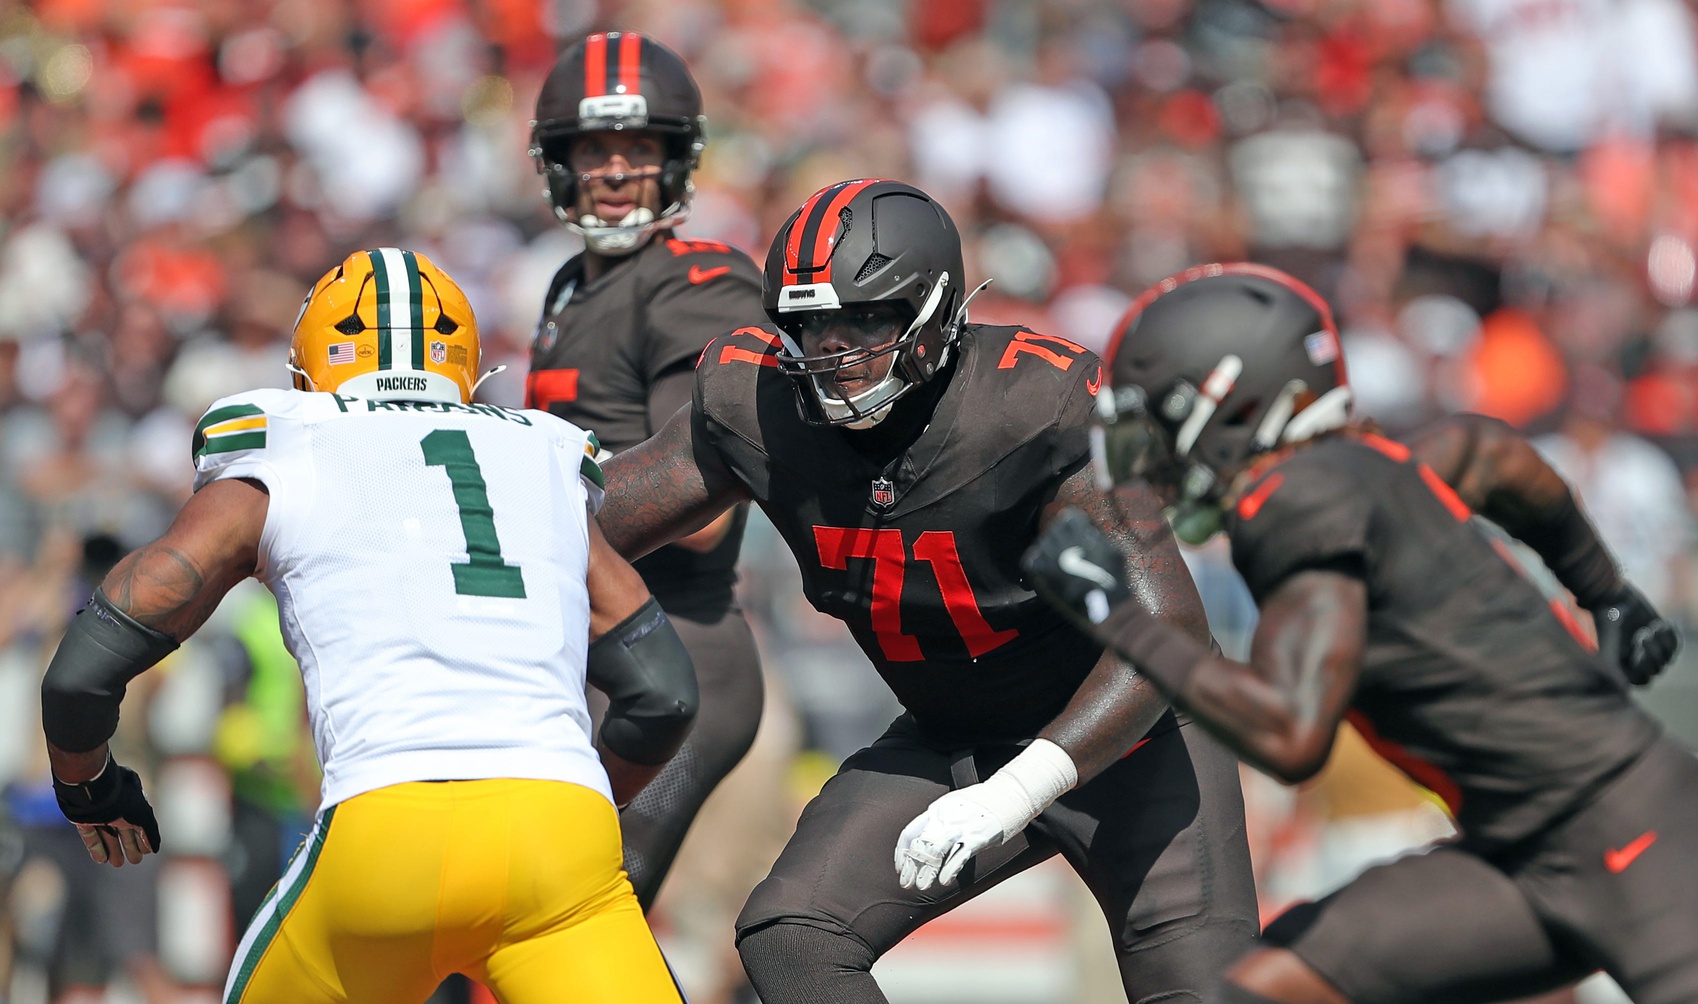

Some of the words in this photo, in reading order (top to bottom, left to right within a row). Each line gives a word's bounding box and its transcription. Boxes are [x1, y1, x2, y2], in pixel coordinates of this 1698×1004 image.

[376, 376, 427, 391] PACKERS
[997, 330, 1087, 371] 71
[420, 429, 528, 599] 1
[812, 525, 1020, 661] 71
